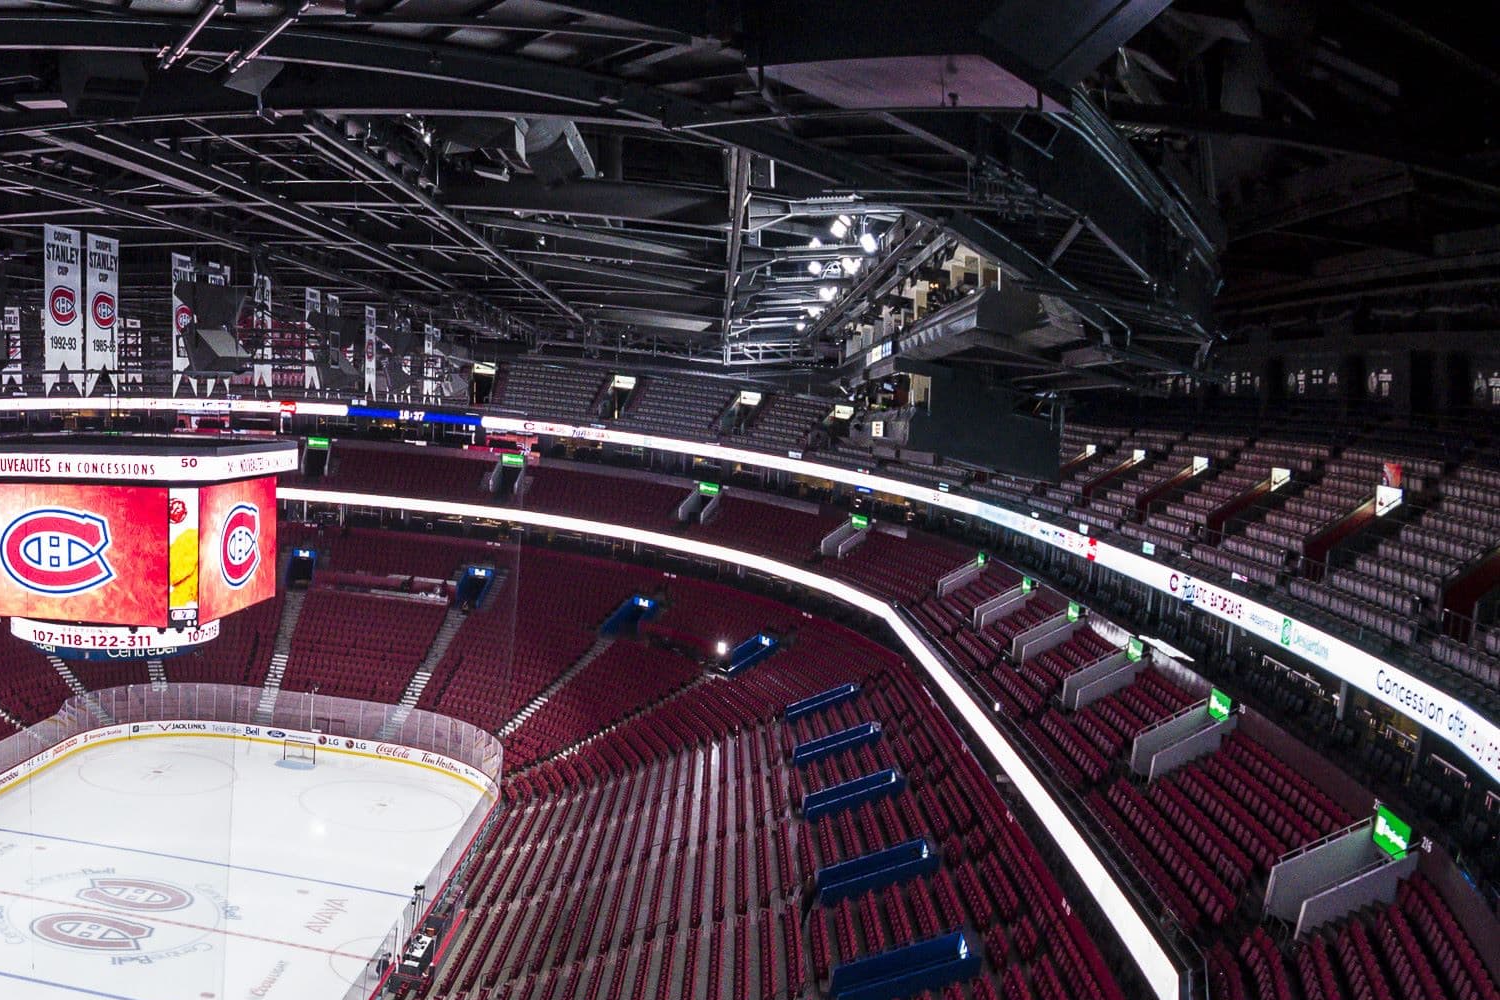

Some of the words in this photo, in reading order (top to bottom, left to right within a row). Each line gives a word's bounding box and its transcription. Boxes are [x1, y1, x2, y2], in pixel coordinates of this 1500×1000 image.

[54, 231, 72, 243] COUPE
[95, 239, 112, 252] COUPE
[46, 243, 79, 264] STANLEY
[89, 252, 118, 272] STANLEY
[57, 266, 69, 276] CUP
[98, 273, 108, 283] CUP
[50, 336, 77, 350] 1992-93
[58, 461, 71, 473] EN
[77, 461, 155, 475] CONCESSIONS
[181, 458, 198, 468] 50
[33, 629, 151, 647] 107-118-122-311
[1376, 669, 1443, 725] Concession
[245, 726, 260, 737] Bell
[328, 738, 339, 746] LG
[356, 742, 367, 750] LG
[420, 752, 434, 765] Tim
[304, 898, 349, 935] AVAYA
